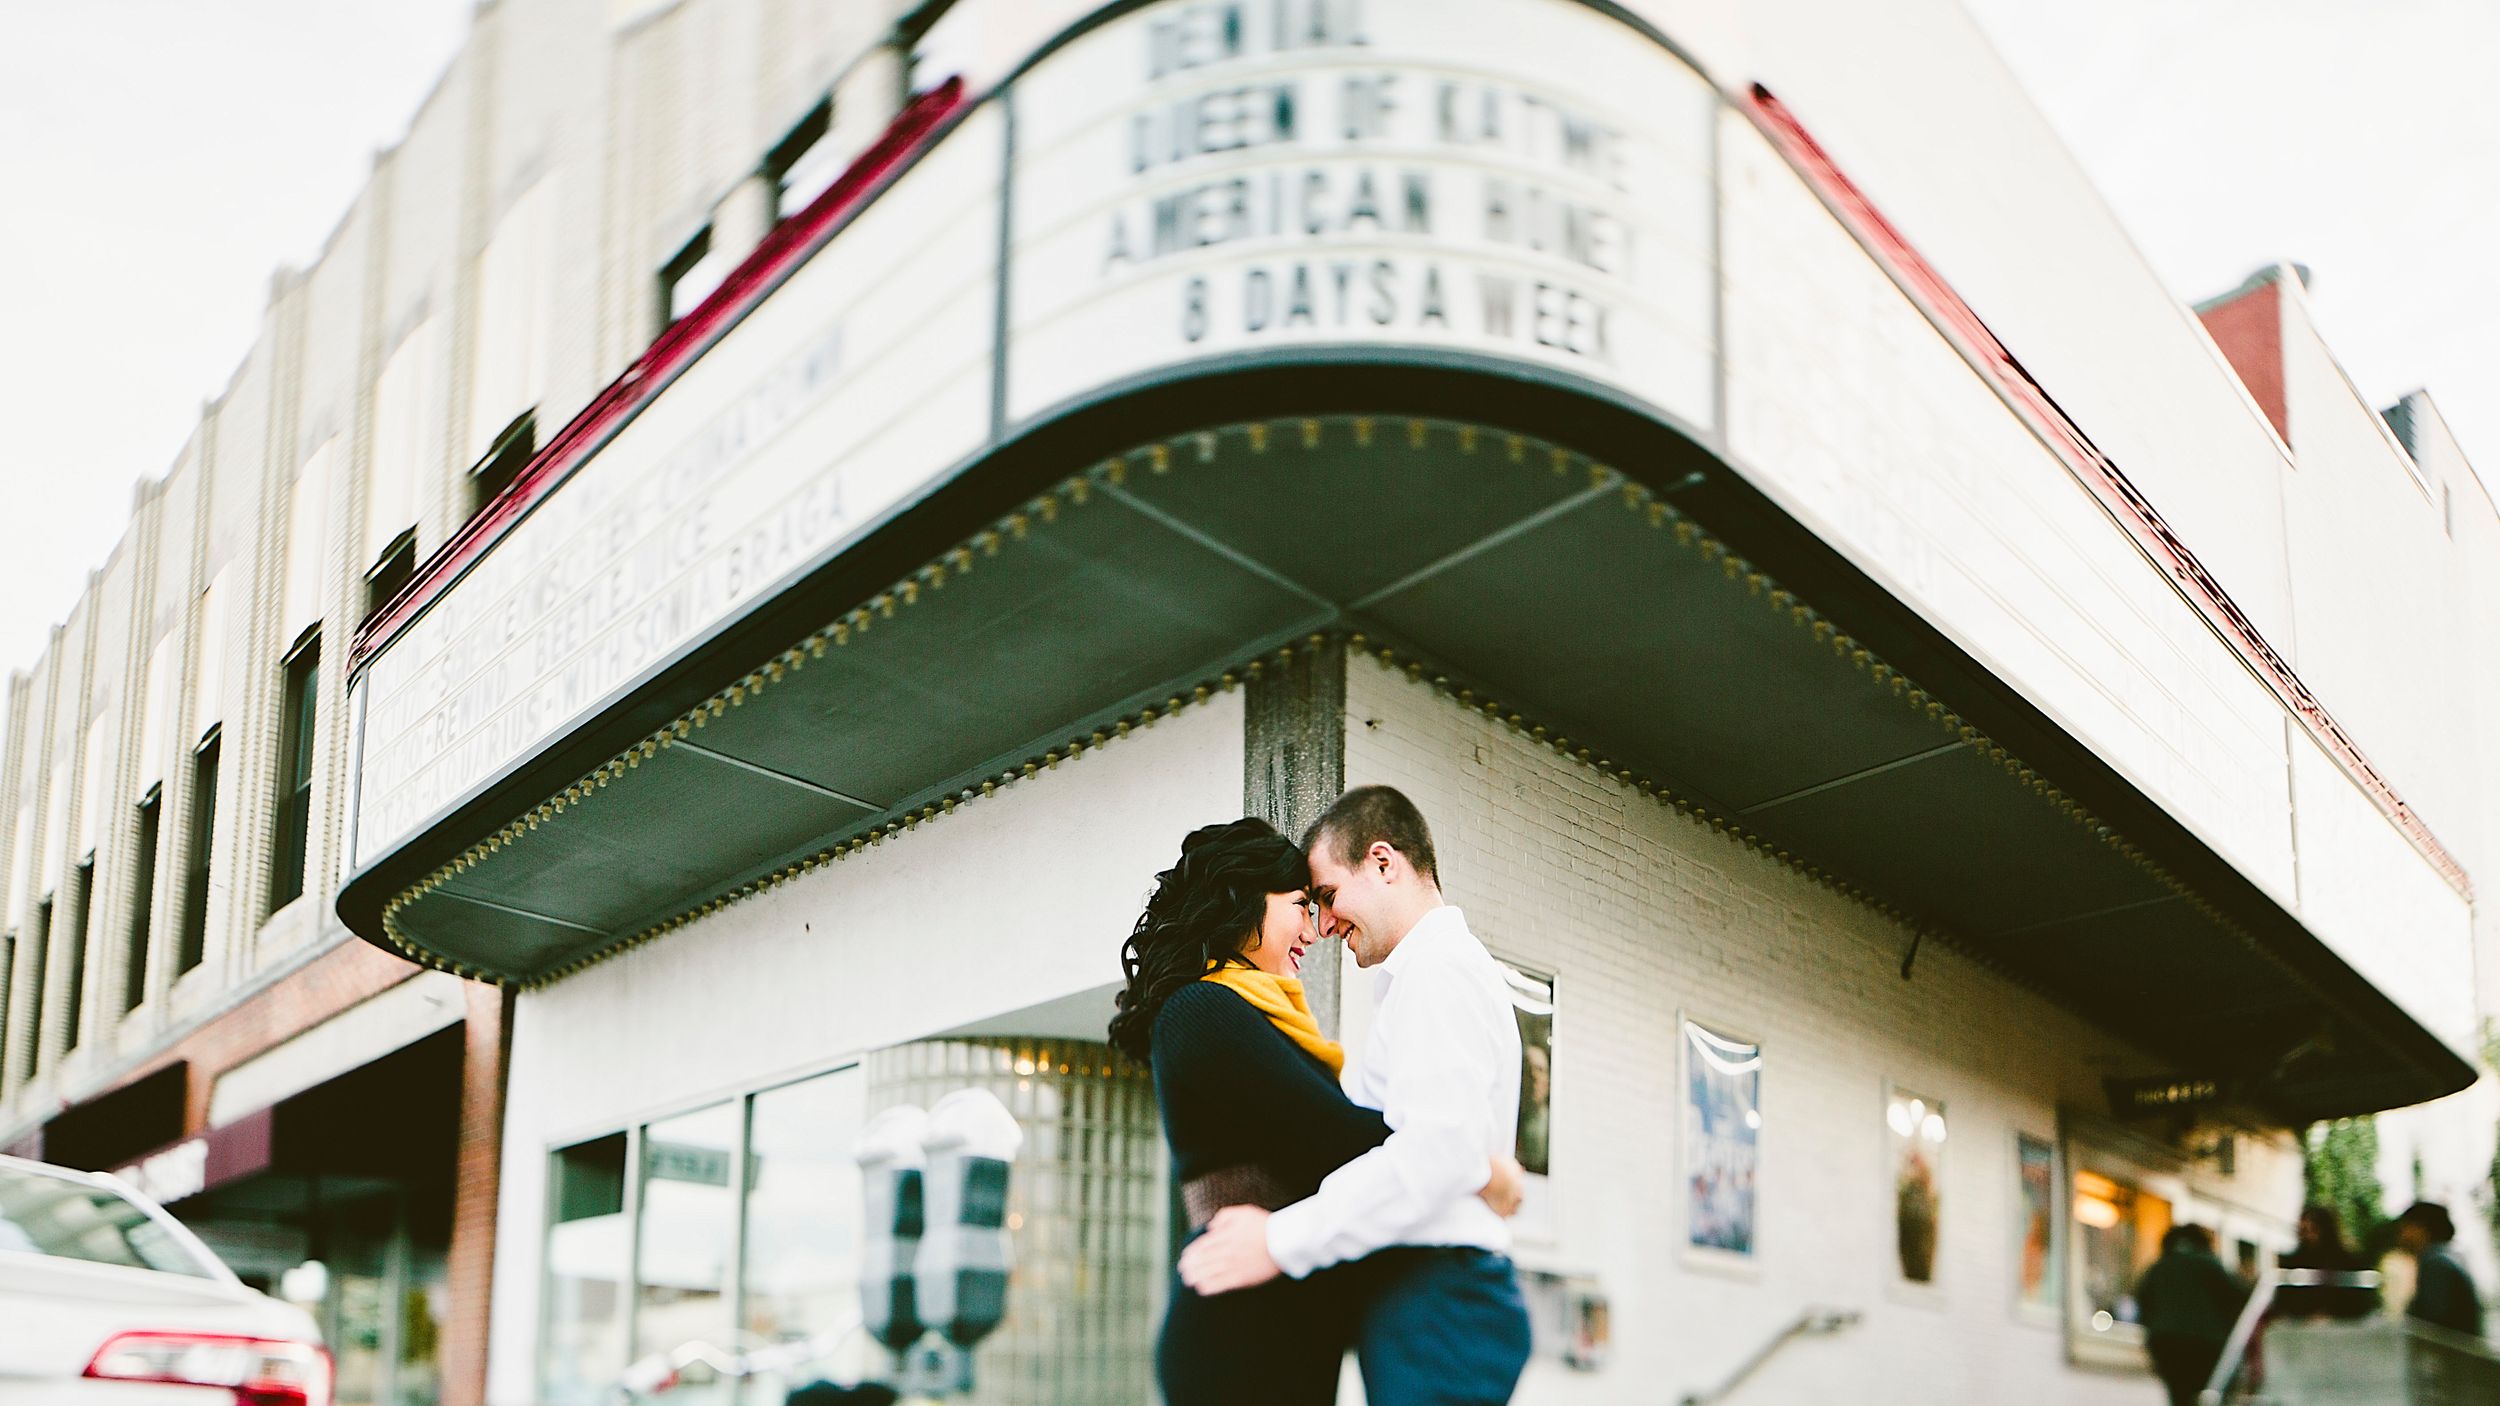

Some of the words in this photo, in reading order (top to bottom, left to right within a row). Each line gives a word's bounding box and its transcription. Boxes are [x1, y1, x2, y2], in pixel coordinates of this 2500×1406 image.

[1104, 165, 1435, 276] AMERICAN
[1180, 277, 1209, 343] 8
[1475, 270, 1615, 364] WEEK
